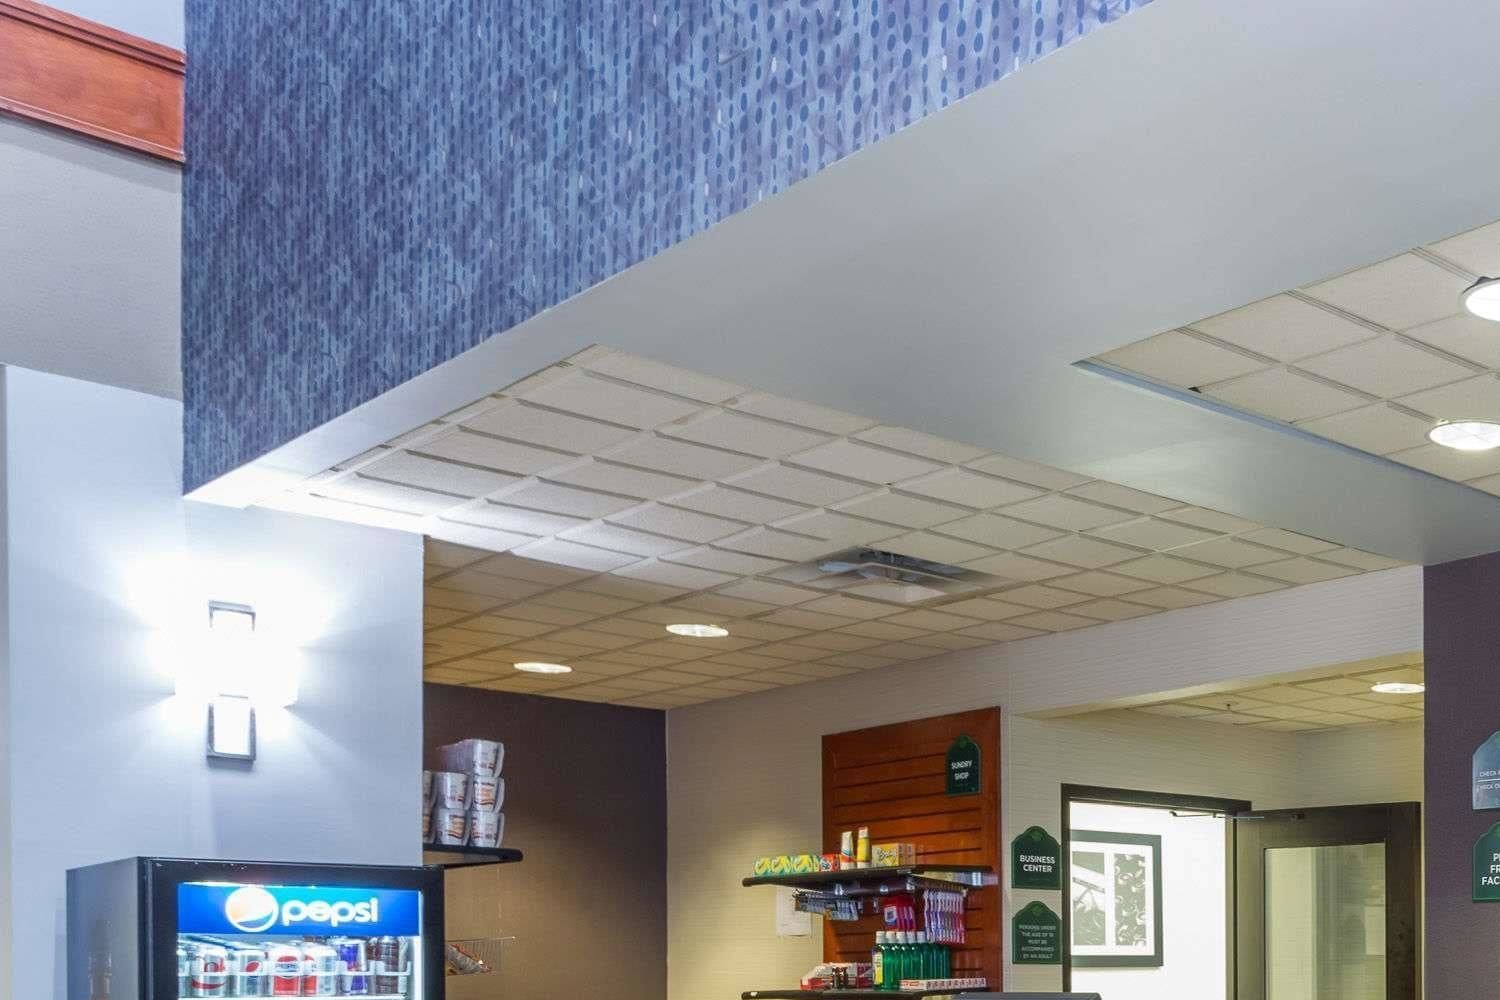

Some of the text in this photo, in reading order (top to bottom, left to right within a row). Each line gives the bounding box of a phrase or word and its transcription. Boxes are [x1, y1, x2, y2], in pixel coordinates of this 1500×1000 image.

[1019, 854, 1056, 864] BUSINESS
[1023, 864, 1053, 872] CENTER
[281, 897, 379, 927] pepsi
